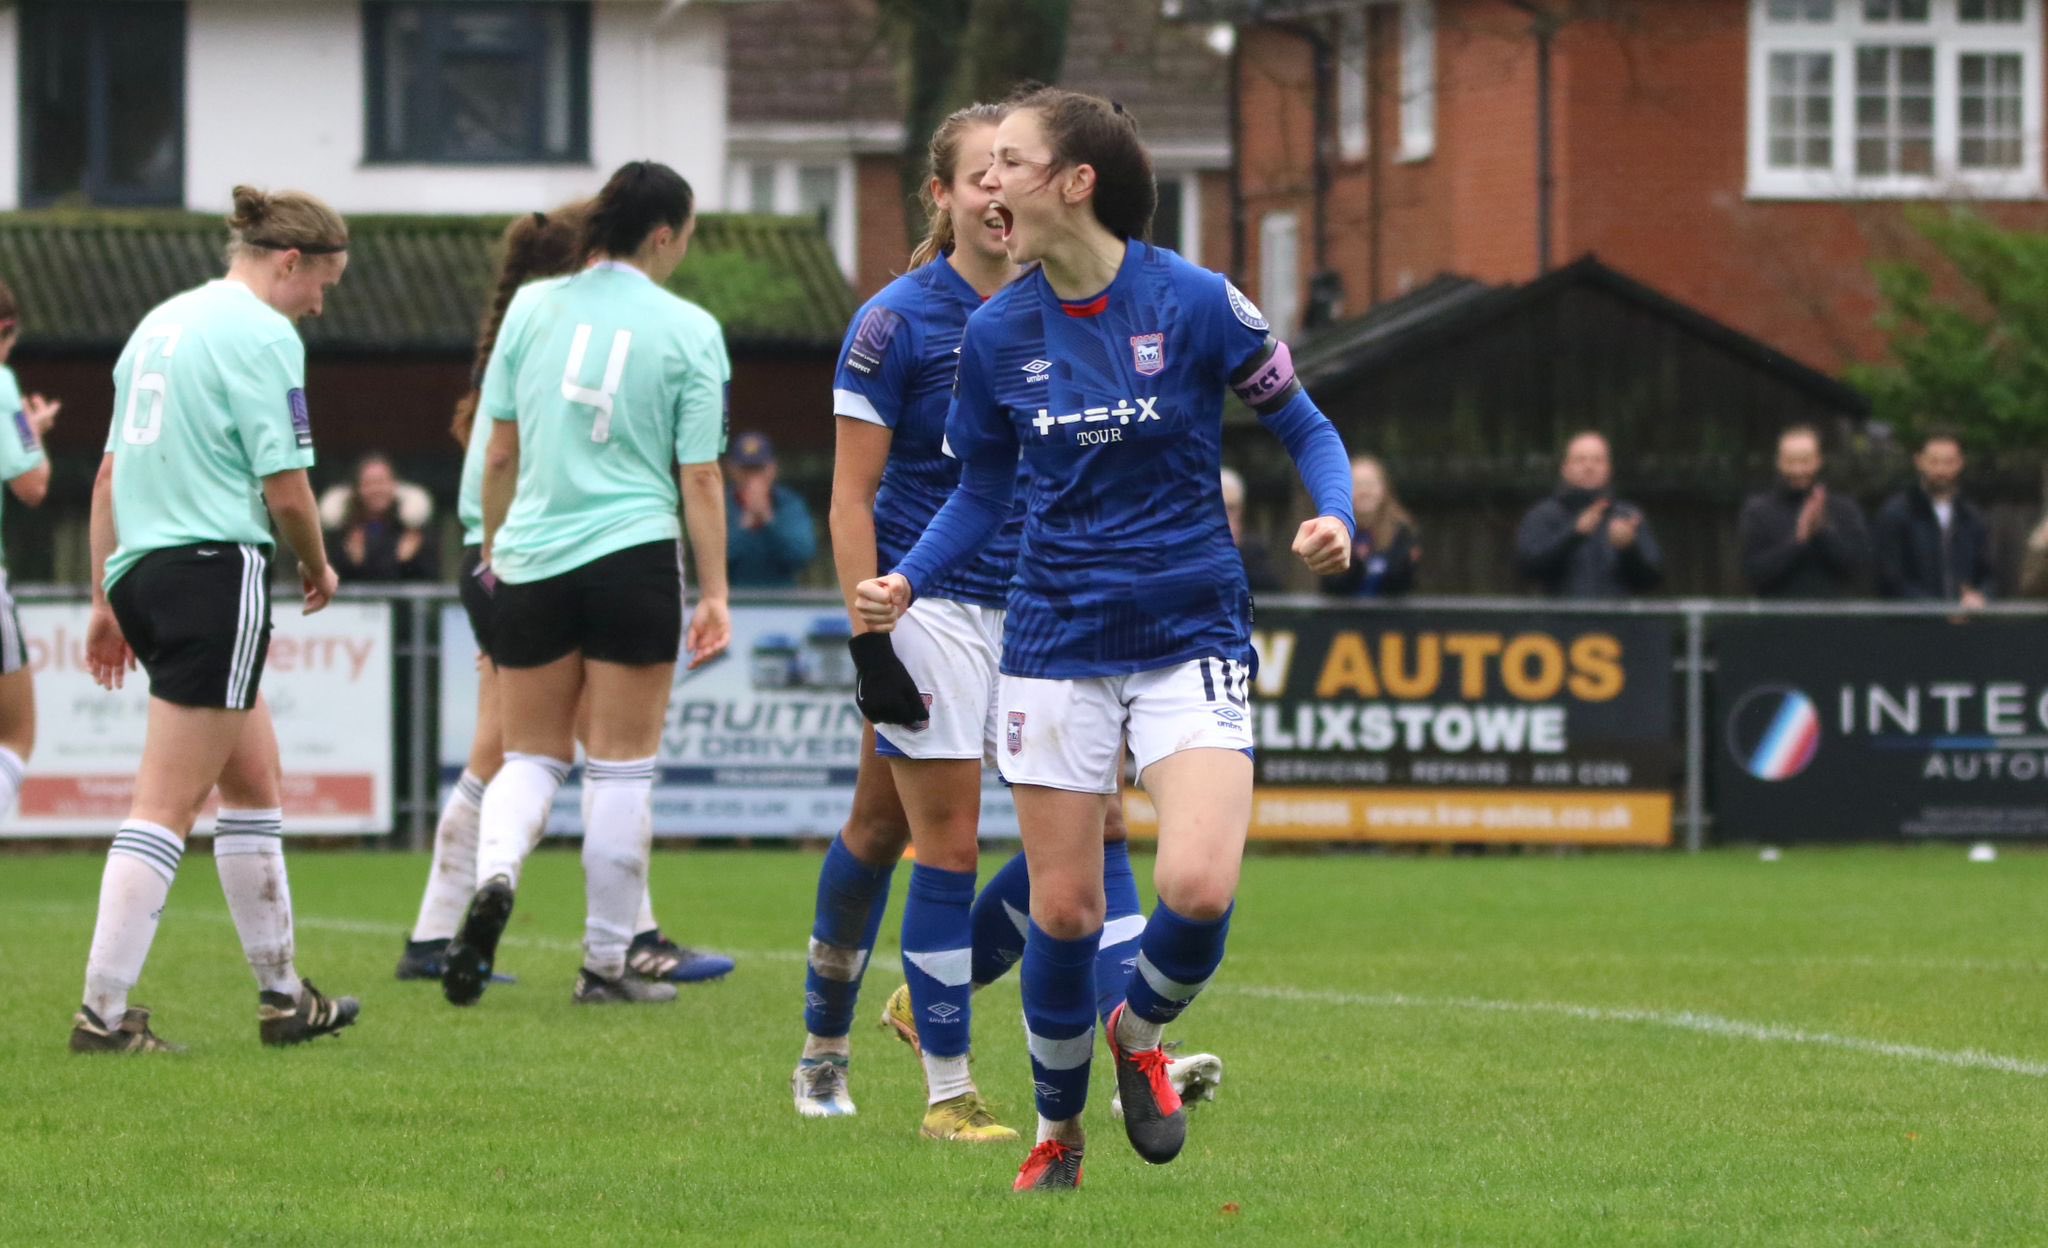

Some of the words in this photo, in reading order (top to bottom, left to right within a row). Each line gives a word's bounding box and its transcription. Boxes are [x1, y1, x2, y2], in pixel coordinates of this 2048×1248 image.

[122, 325, 182, 445] 6
[561, 324, 632, 443] 4
[1026, 373, 1050, 383] umbro
[1077, 428, 1123, 446] TOUR
[1316, 631, 1624, 700] AUTOS
